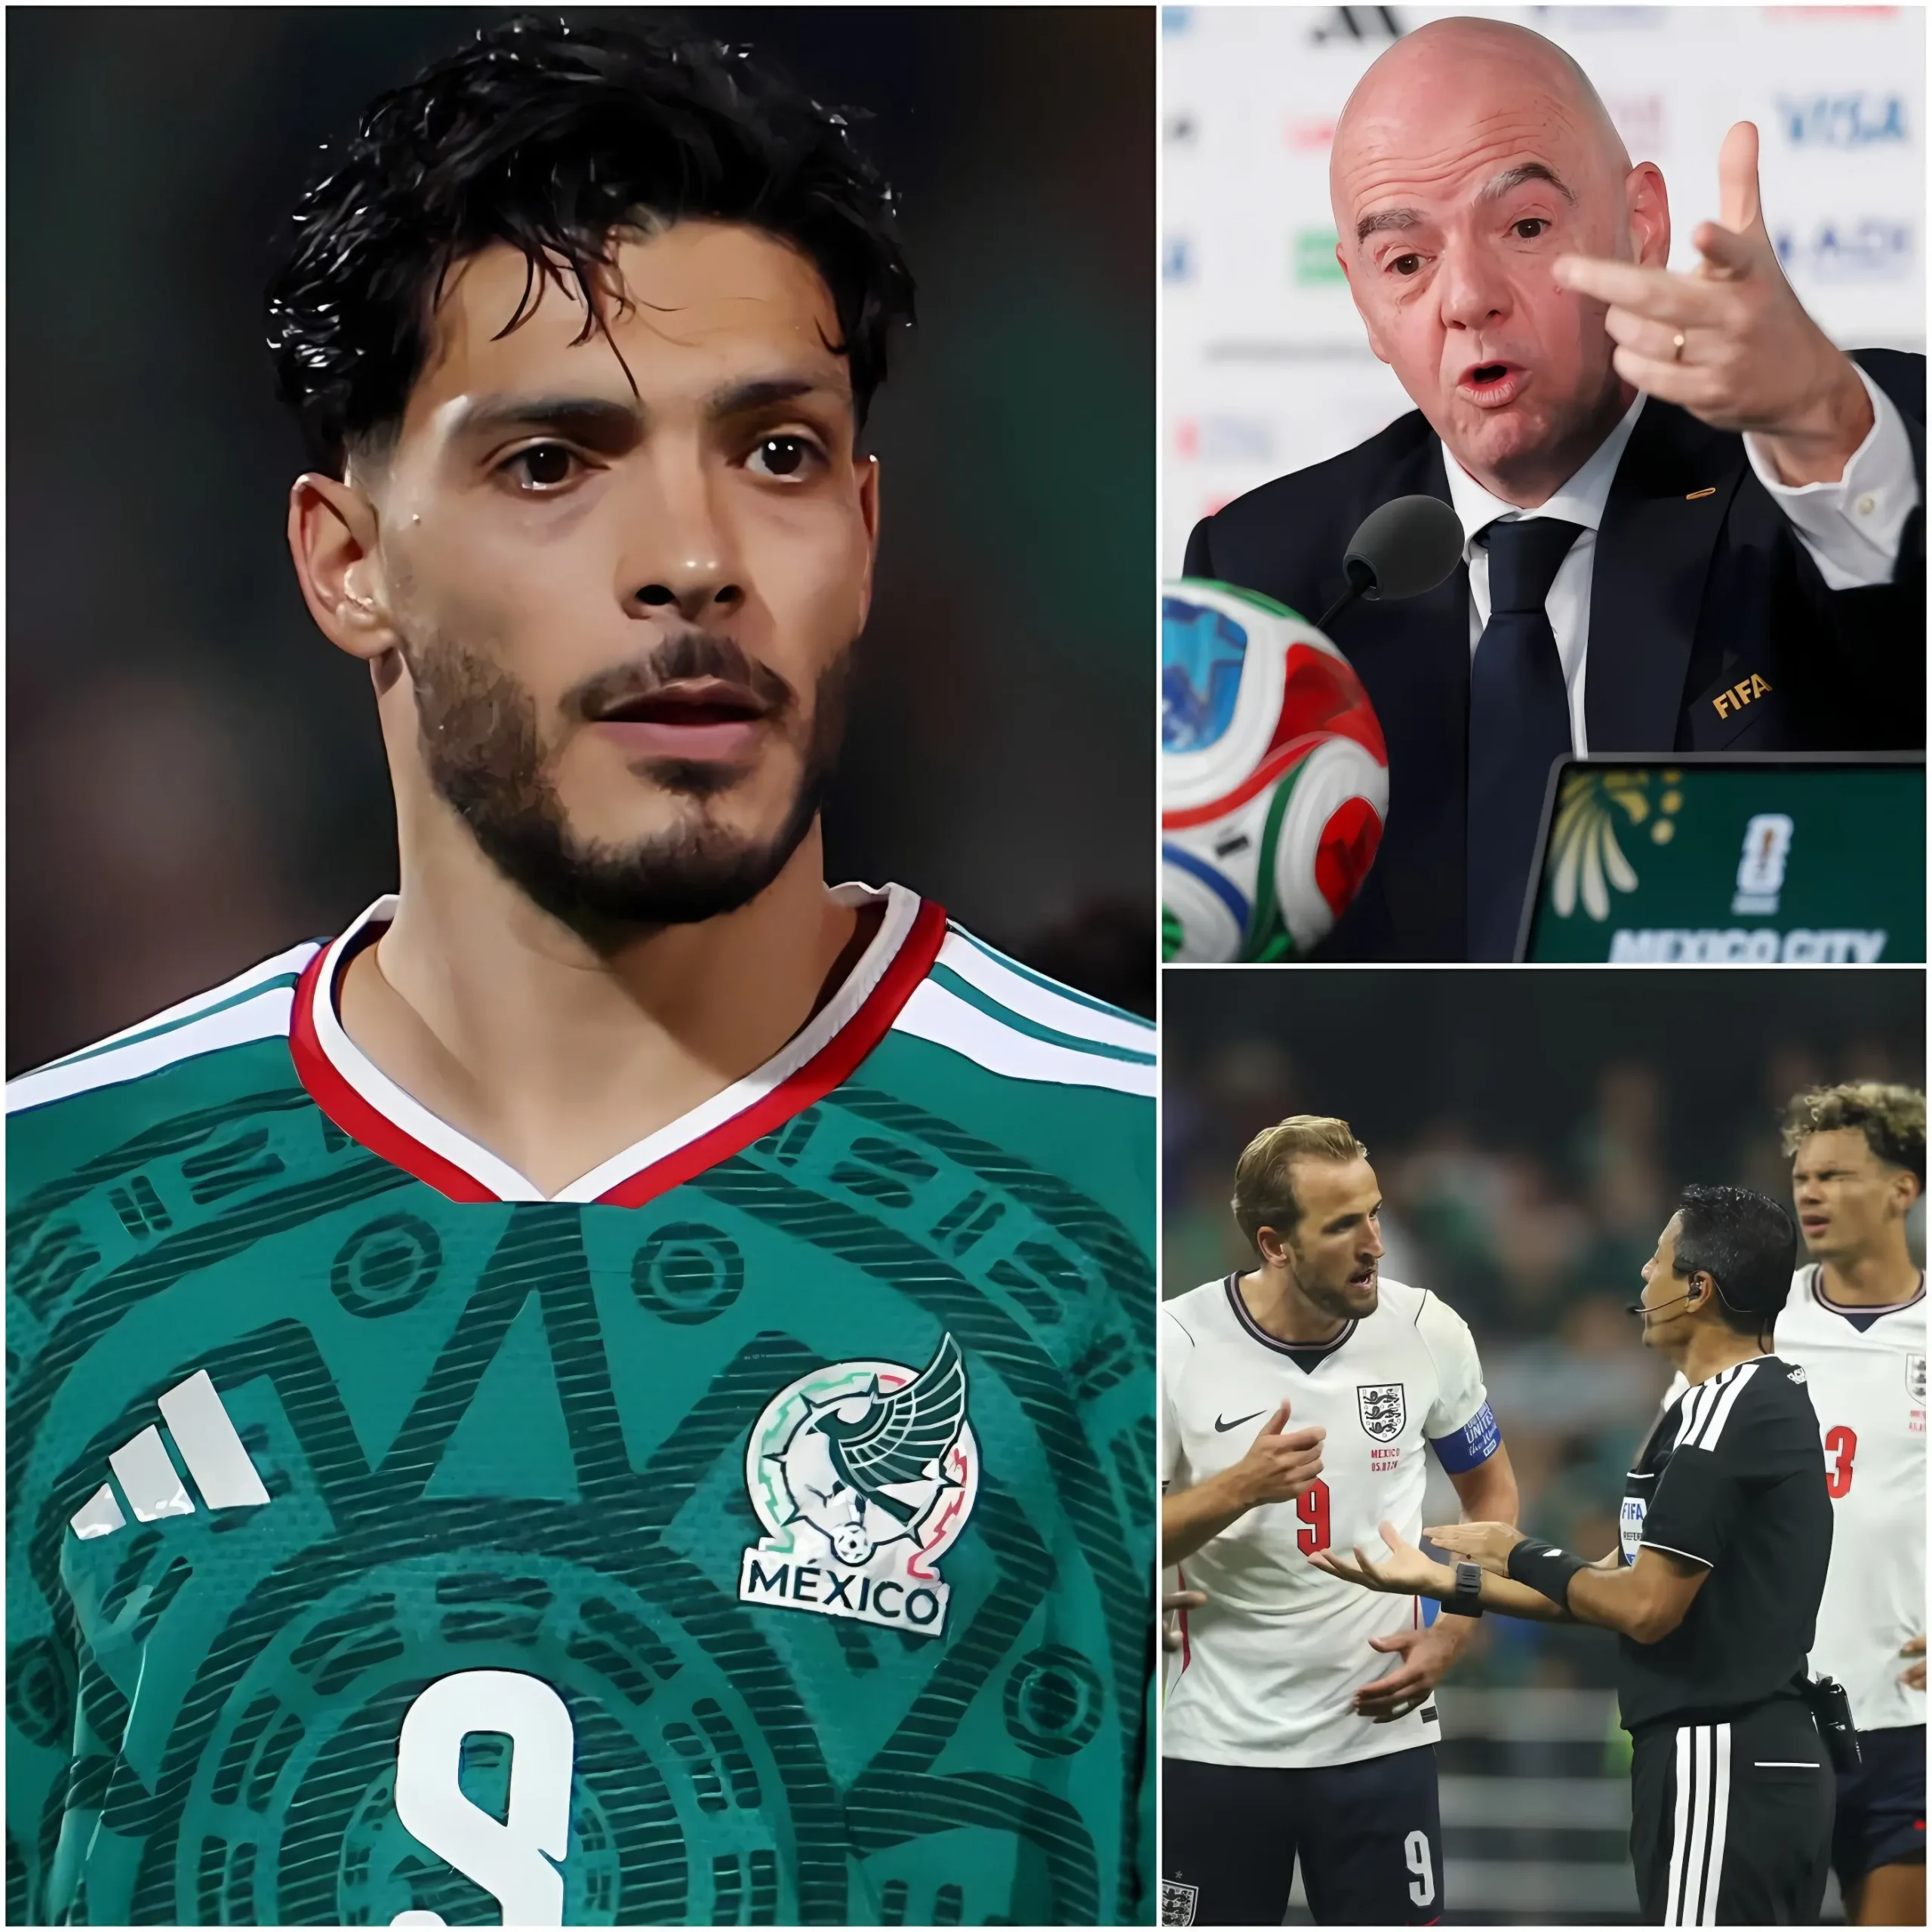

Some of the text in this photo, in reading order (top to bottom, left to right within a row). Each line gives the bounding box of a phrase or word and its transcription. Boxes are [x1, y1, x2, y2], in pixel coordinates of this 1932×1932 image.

[1712, 673, 1773, 719] FIFA
[1608, 928, 1887, 962] MEXICO CITY
[1825, 1425, 1857, 1499] 3
[1297, 1476, 1331, 1557] 9
[1622, 1503, 1643, 1520] FIFA
[389, 1669, 574, 1926] 9
[1404, 1829, 1435, 1906] 9
